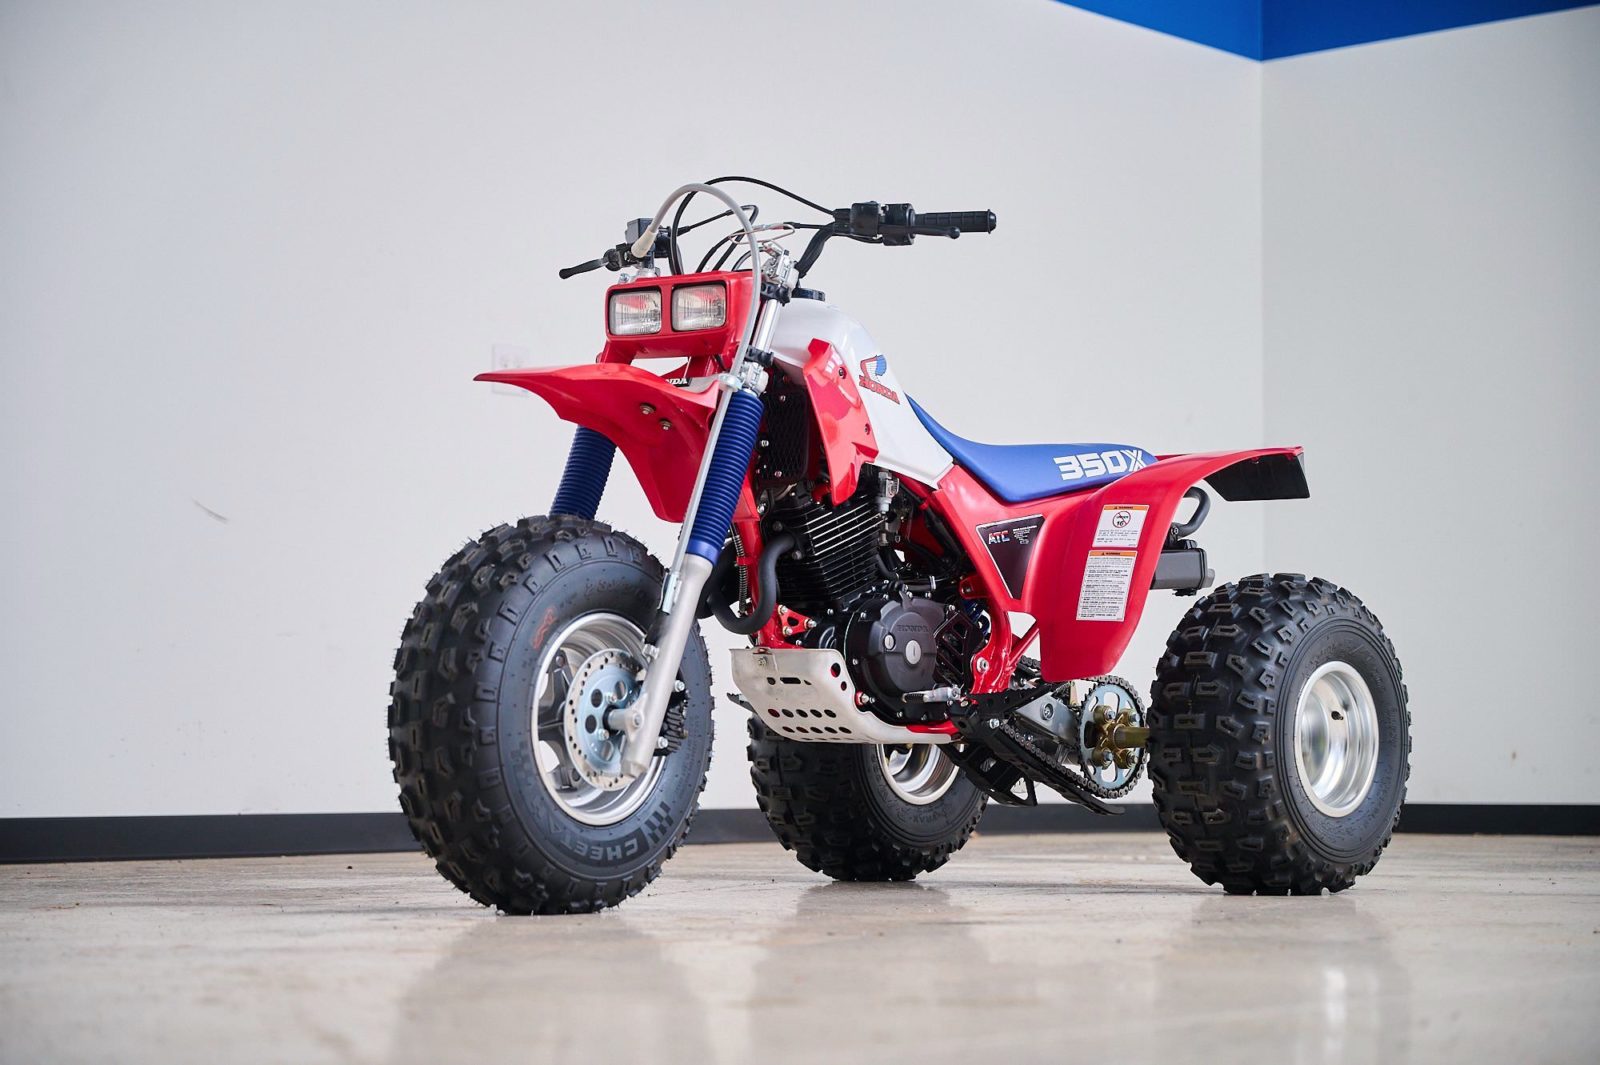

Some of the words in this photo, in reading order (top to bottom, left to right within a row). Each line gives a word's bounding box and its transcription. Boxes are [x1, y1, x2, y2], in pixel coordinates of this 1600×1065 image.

[858, 375, 900, 404] HONDA
[1053, 449, 1147, 480] 350X
[988, 530, 1010, 544] ATC
